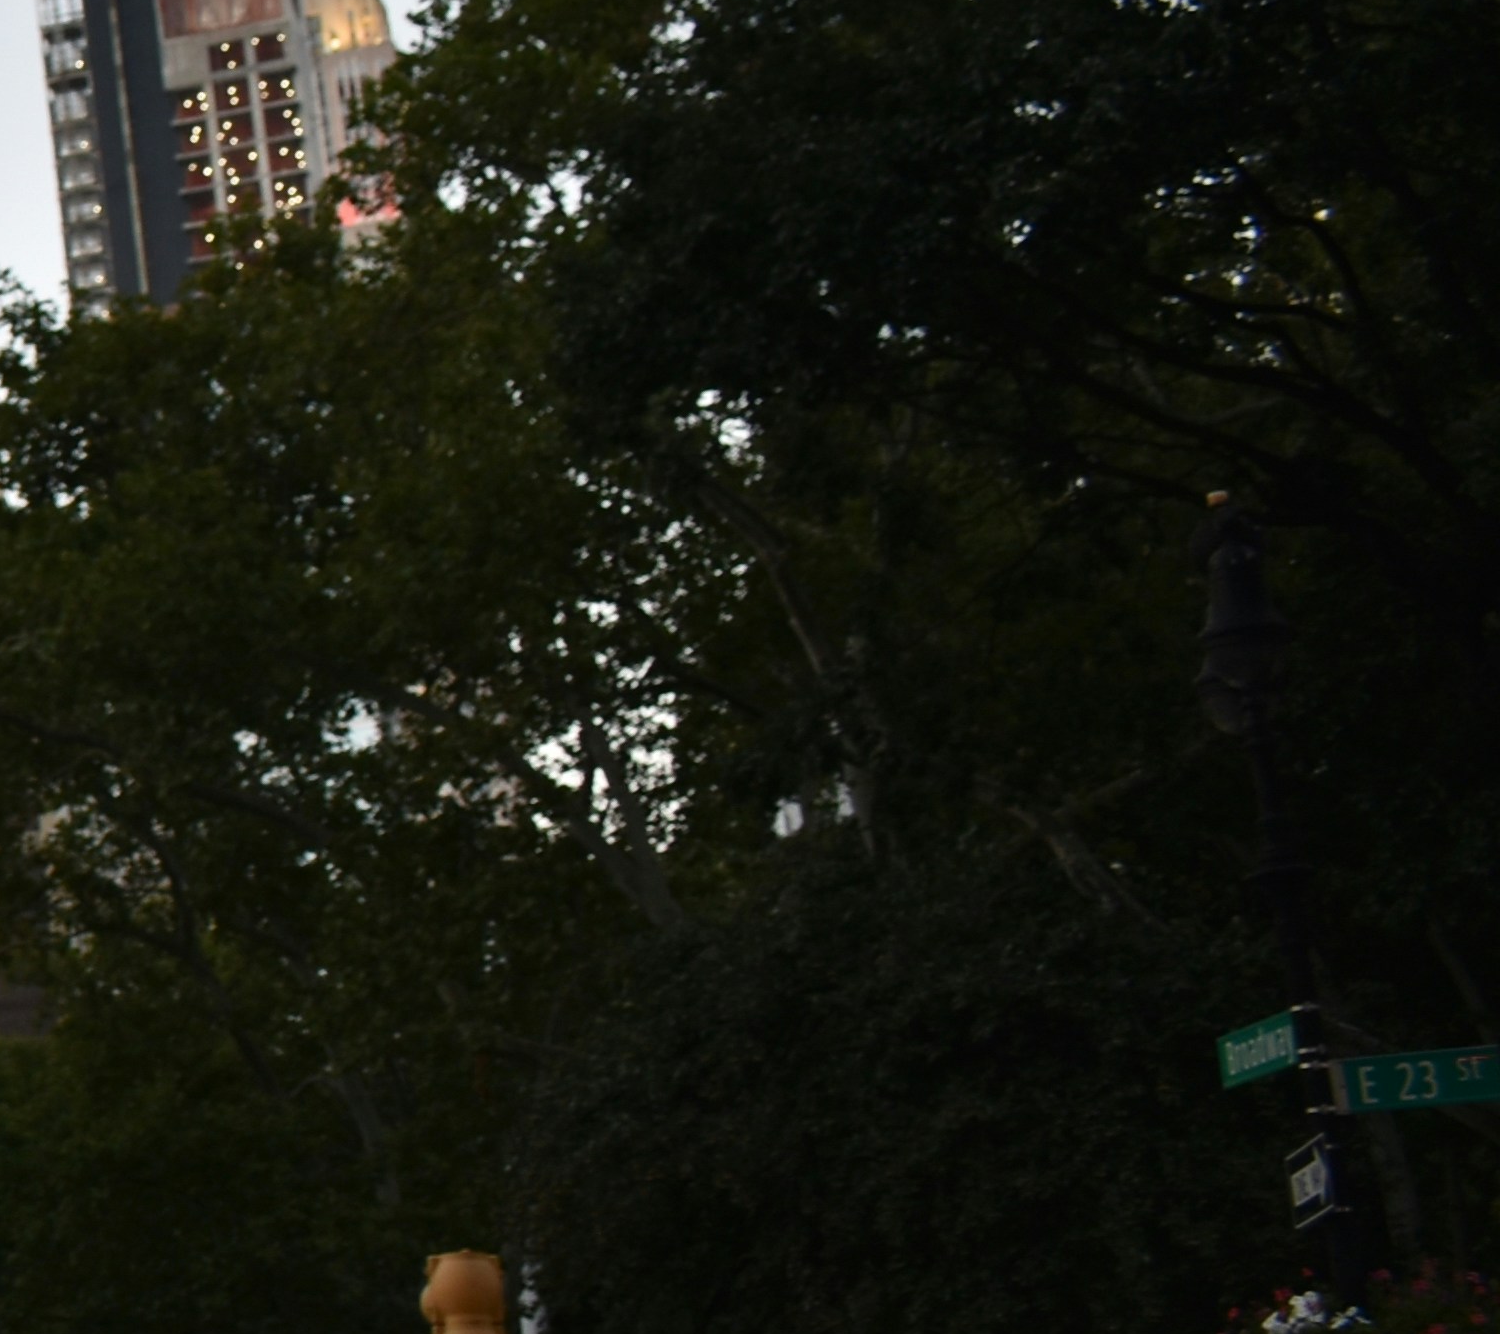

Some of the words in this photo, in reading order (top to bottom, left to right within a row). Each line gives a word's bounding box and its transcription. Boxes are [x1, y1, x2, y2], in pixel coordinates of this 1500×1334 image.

[1225, 1023, 1297, 1077] Broadway
[1357, 1065, 1380, 1104] E
[1394, 1059, 1439, 1101] 23
